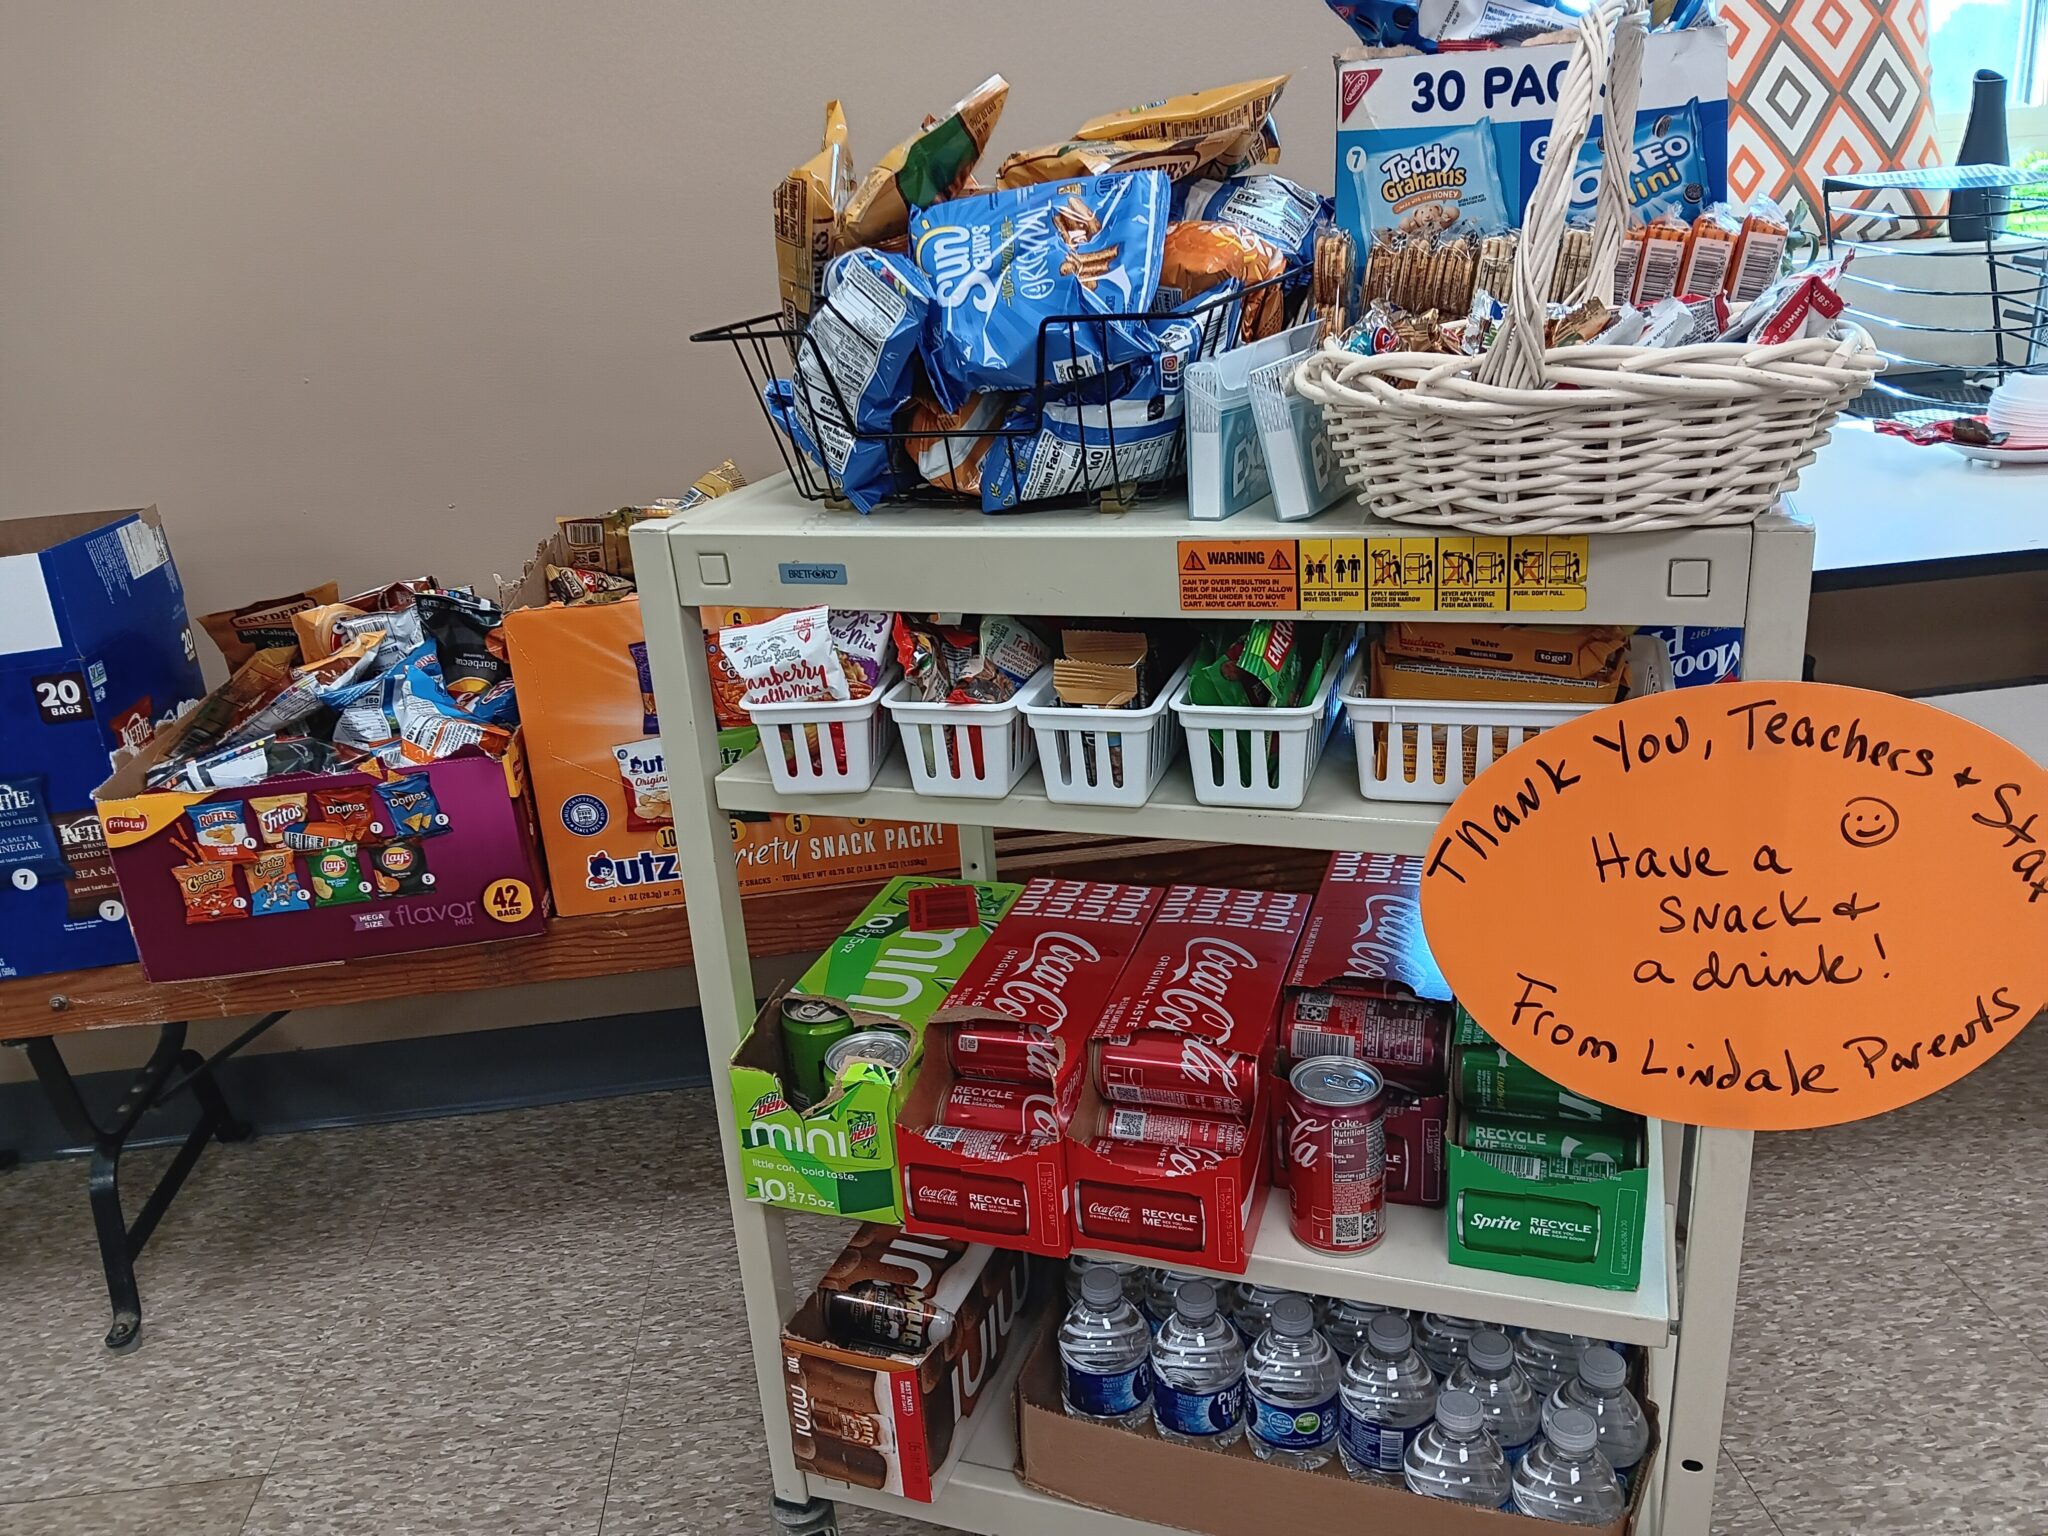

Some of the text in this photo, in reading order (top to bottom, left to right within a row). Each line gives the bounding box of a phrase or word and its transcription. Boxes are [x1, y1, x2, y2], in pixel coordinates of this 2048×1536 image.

[1411, 69, 1466, 113] 30
[1351, 150, 1361, 169] 7
[1380, 143, 1460, 182] Teddy
[1382, 167, 1467, 203] Grahams
[1432, 190, 1459, 200] HONEY
[1779, 303, 1806, 337] GUMMI
[1046, 440, 1064, 470] Facts
[1088, 450, 1104, 470] 140
[1207, 551, 1265, 565] WARNING
[788, 568, 837, 579] BRETFORD
[238, 602, 318, 626] SNYDER'S
[846, 626, 878, 652] Mix
[1471, 638, 1500, 649] Wafer
[1540, 652, 1567, 664] to go!
[36, 679, 81, 708] 20
[793, 683, 822, 698] Mix
[51, 704, 82, 716] BAGS
[1728, 699, 1935, 778] Teachers
[326, 802, 366, 815] Doritos
[390, 791, 428, 808] Doritos
[13, 816, 39, 826] CHIPS
[199, 810, 238, 828] RUFFLES
[261, 804, 302, 834] Fritos
[793, 814, 802, 832] 5
[7, 835, 26, 843] SALT
[661, 829, 677, 848] 10
[733, 822, 945, 869] riety SNACK PACK!
[67, 849, 100, 861] POTATO
[385, 851, 411, 864] Lay's
[1591, 831, 1794, 883] Have a
[75, 868, 98, 879] SEA
[253, 855, 286, 878] Cheetos
[322, 859, 346, 872] Lay's
[614, 852, 680, 886] utz
[19, 874, 28, 885] 7
[186, 868, 226, 893] Cheetos
[745, 866, 855, 887] SNACKS TOTAL NET WT OZ
[492, 885, 521, 909] 42
[1010, 878, 1056, 917] mini
[1043, 880, 1088, 920] mini
[1075, 883, 1120, 923] mini
[1108, 885, 1152, 926] mini
[1156, 886, 1198, 924] mini
[106, 905, 115, 916] 7
[395, 900, 476, 926] flavor
[496, 907, 522, 917] BAGS
[1190, 888, 1231, 926] mini
[1225, 890, 1264, 929] mini
[1259, 893, 1301, 934] mini
[1658, 890, 1822, 934] Snack
[359, 913, 385, 922] MEGA
[364, 920, 384, 929] SIZE
[454, 917, 474, 927] MIX
[865, 912, 901, 929] 10
[983, 949, 1019, 988] ORIGINAL
[1632, 958, 1676, 986] a
[1126, 955, 1172, 1029] ORIGINAL TASTE
[1511, 971, 1618, 1065] From
[1641, 1038, 1840, 1098] Lindale
[1842, 986, 2022, 1080] Parents
[950, 1094, 971, 1105] ME
[953, 1085, 1015, 1100] RECYCLE
[1331, 1119, 1360, 1128] Coke
[1334, 1128, 1365, 1137] Nutrition
[750, 1121, 848, 1158] mini
[1334, 1137, 1355, 1145] Facts
[1475, 1126, 1547, 1145] RECYCLE
[752, 1158, 858, 1182] little can. bold taste.
[754, 1176, 836, 1209] 10 7.5oz
[918, 1185, 959, 1202] Coca-Cola
[968, 1193, 1022, 1208] RECYCLE
[969, 1201, 988, 1211] ME
[1088, 1202, 1132, 1219] Coca-Cola
[1141, 1208, 1198, 1224] RECYCLE
[1142, 1216, 1162, 1227] ME
[1470, 1213, 1521, 1231] Sprite
[1529, 1217, 1592, 1234] RECYCLE
[1529, 1226, 1551, 1237] ME
[905, 1380, 914, 1412] BEST TASTE
[1217, 1382, 1243, 1405] Pure
[791, 1384, 812, 1438] mini
[1221, 1398, 1242, 1415] Life
[856, 1411, 874, 1446] MUG
